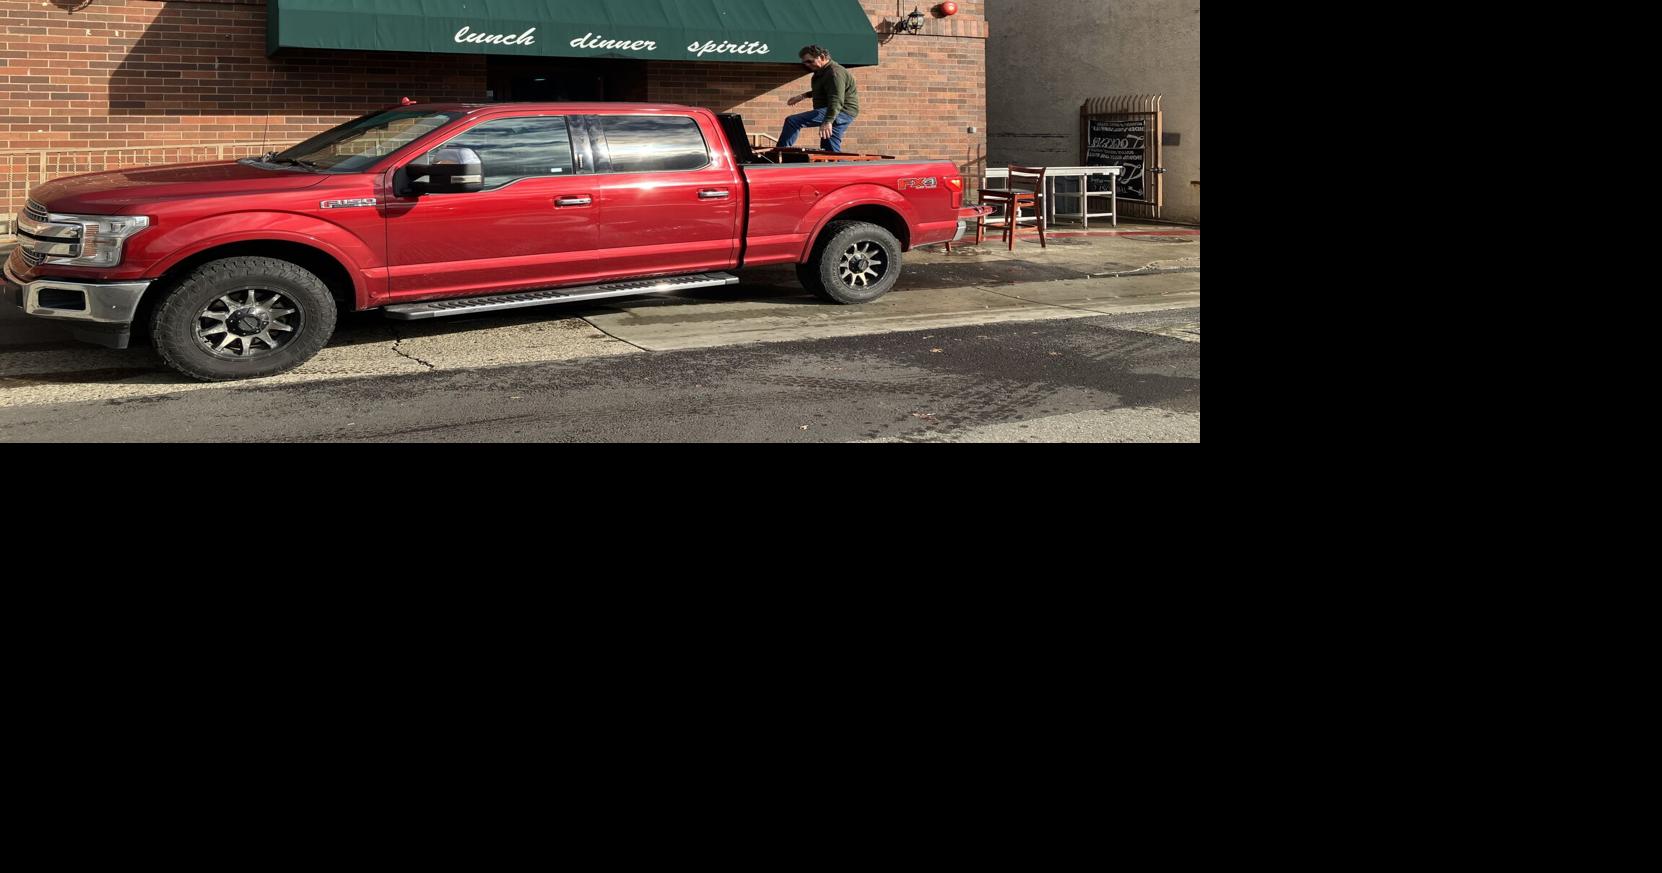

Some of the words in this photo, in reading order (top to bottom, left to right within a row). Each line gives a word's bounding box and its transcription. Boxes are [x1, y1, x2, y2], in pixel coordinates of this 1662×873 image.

[454, 25, 537, 46] lunch
[569, 32, 657, 51] dinner
[686, 40, 770, 57] spirits
[897, 177, 937, 190] FX4
